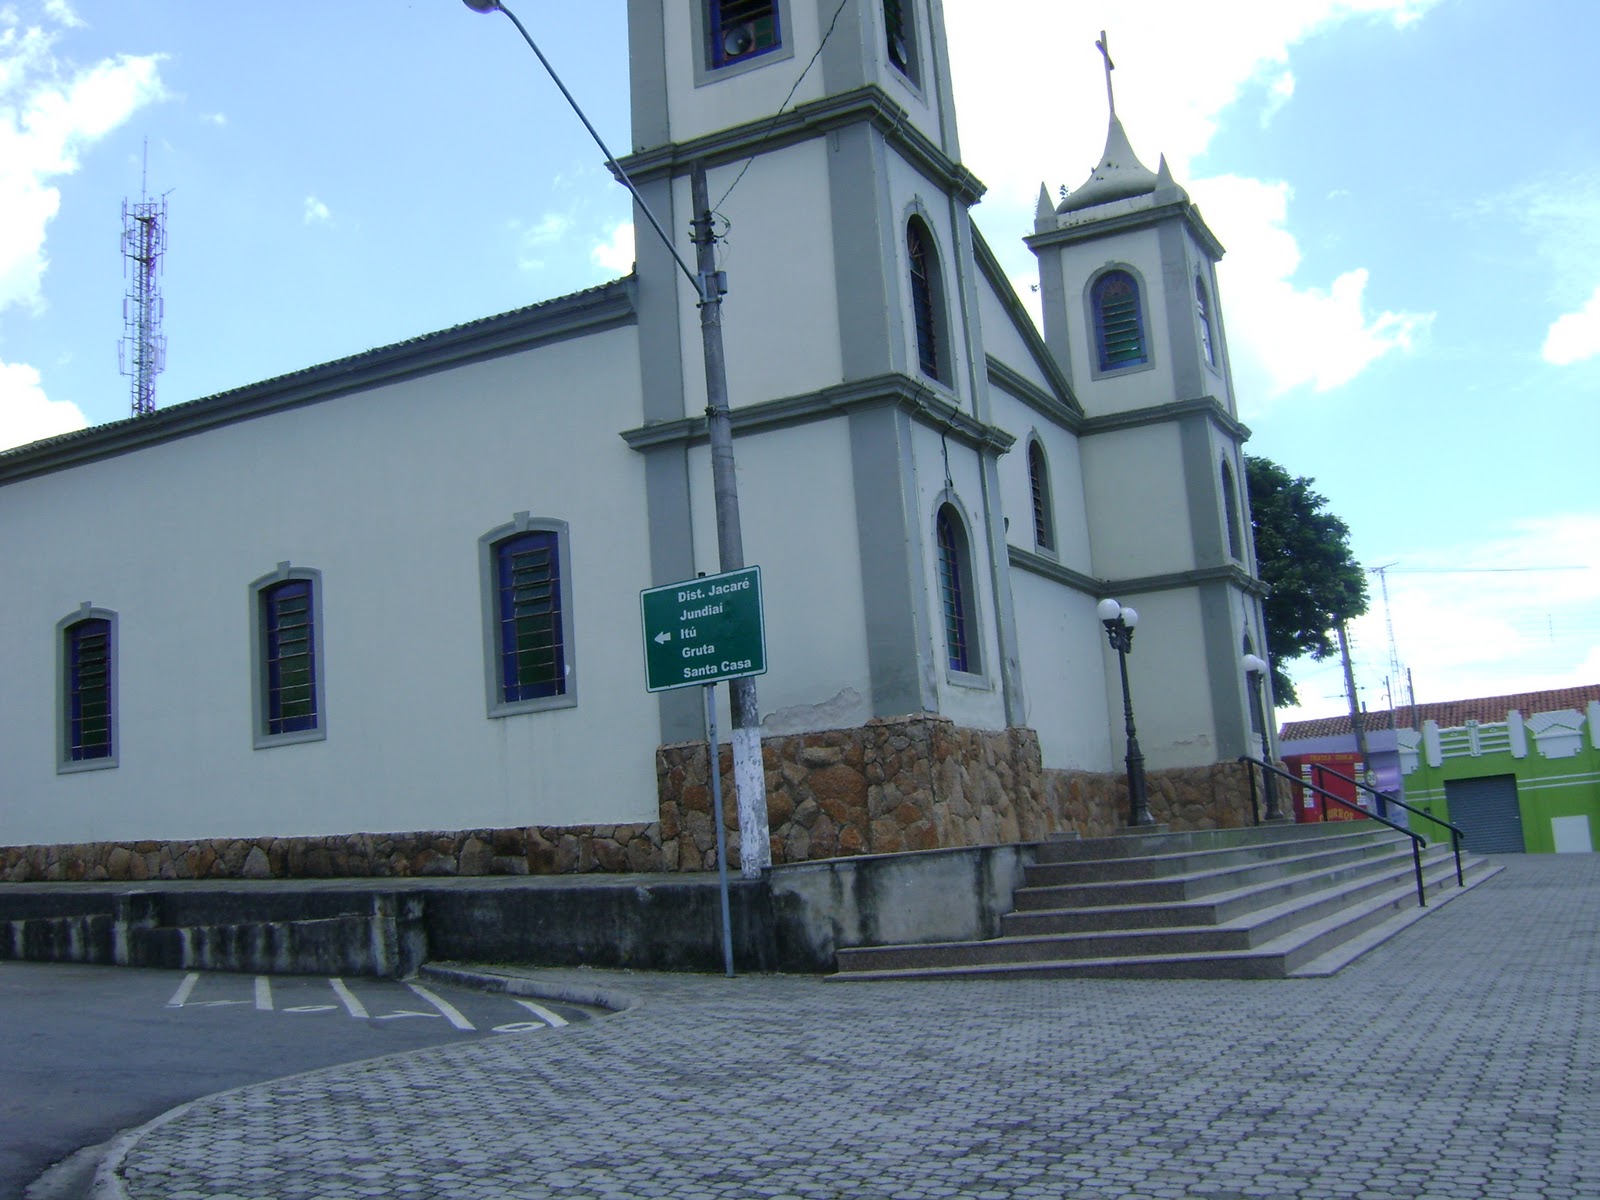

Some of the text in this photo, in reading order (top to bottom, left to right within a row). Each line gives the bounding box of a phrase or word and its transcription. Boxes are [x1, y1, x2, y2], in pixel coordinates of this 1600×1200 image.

[678, 578, 750, 602] Dist. Jacaré
[680, 602, 723, 620] Jundiaí
[680, 626, 697, 639] Itú
[682, 644, 715, 658] Gruta
[683, 659, 752, 678] Santa Casa
[1319, 808, 1354, 821] CURROS
